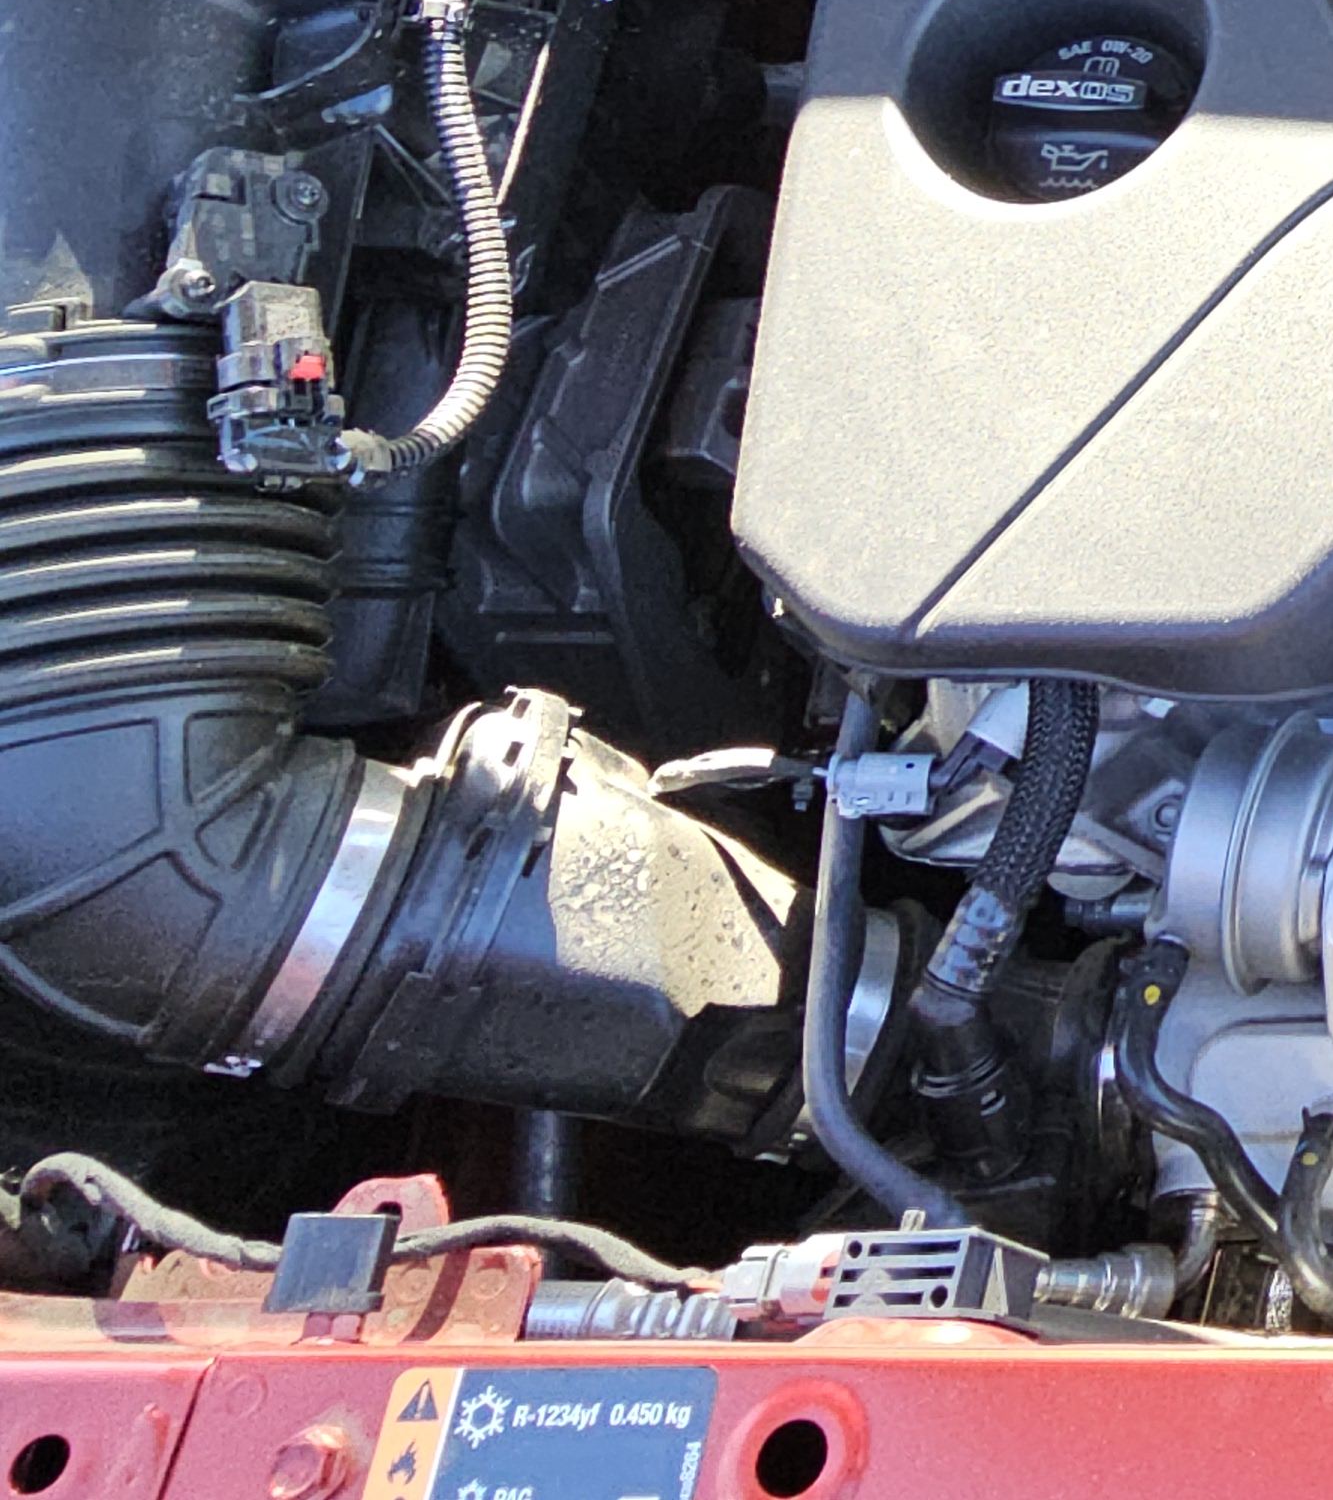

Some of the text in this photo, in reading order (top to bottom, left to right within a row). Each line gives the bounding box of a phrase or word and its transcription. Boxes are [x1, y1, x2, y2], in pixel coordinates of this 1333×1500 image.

[1058, 39, 1154, 64] SAE 0W-20
[1002, 75, 1136, 103] dexos
[512, 1402, 692, 1432] R-1234yf 0.450 kg
